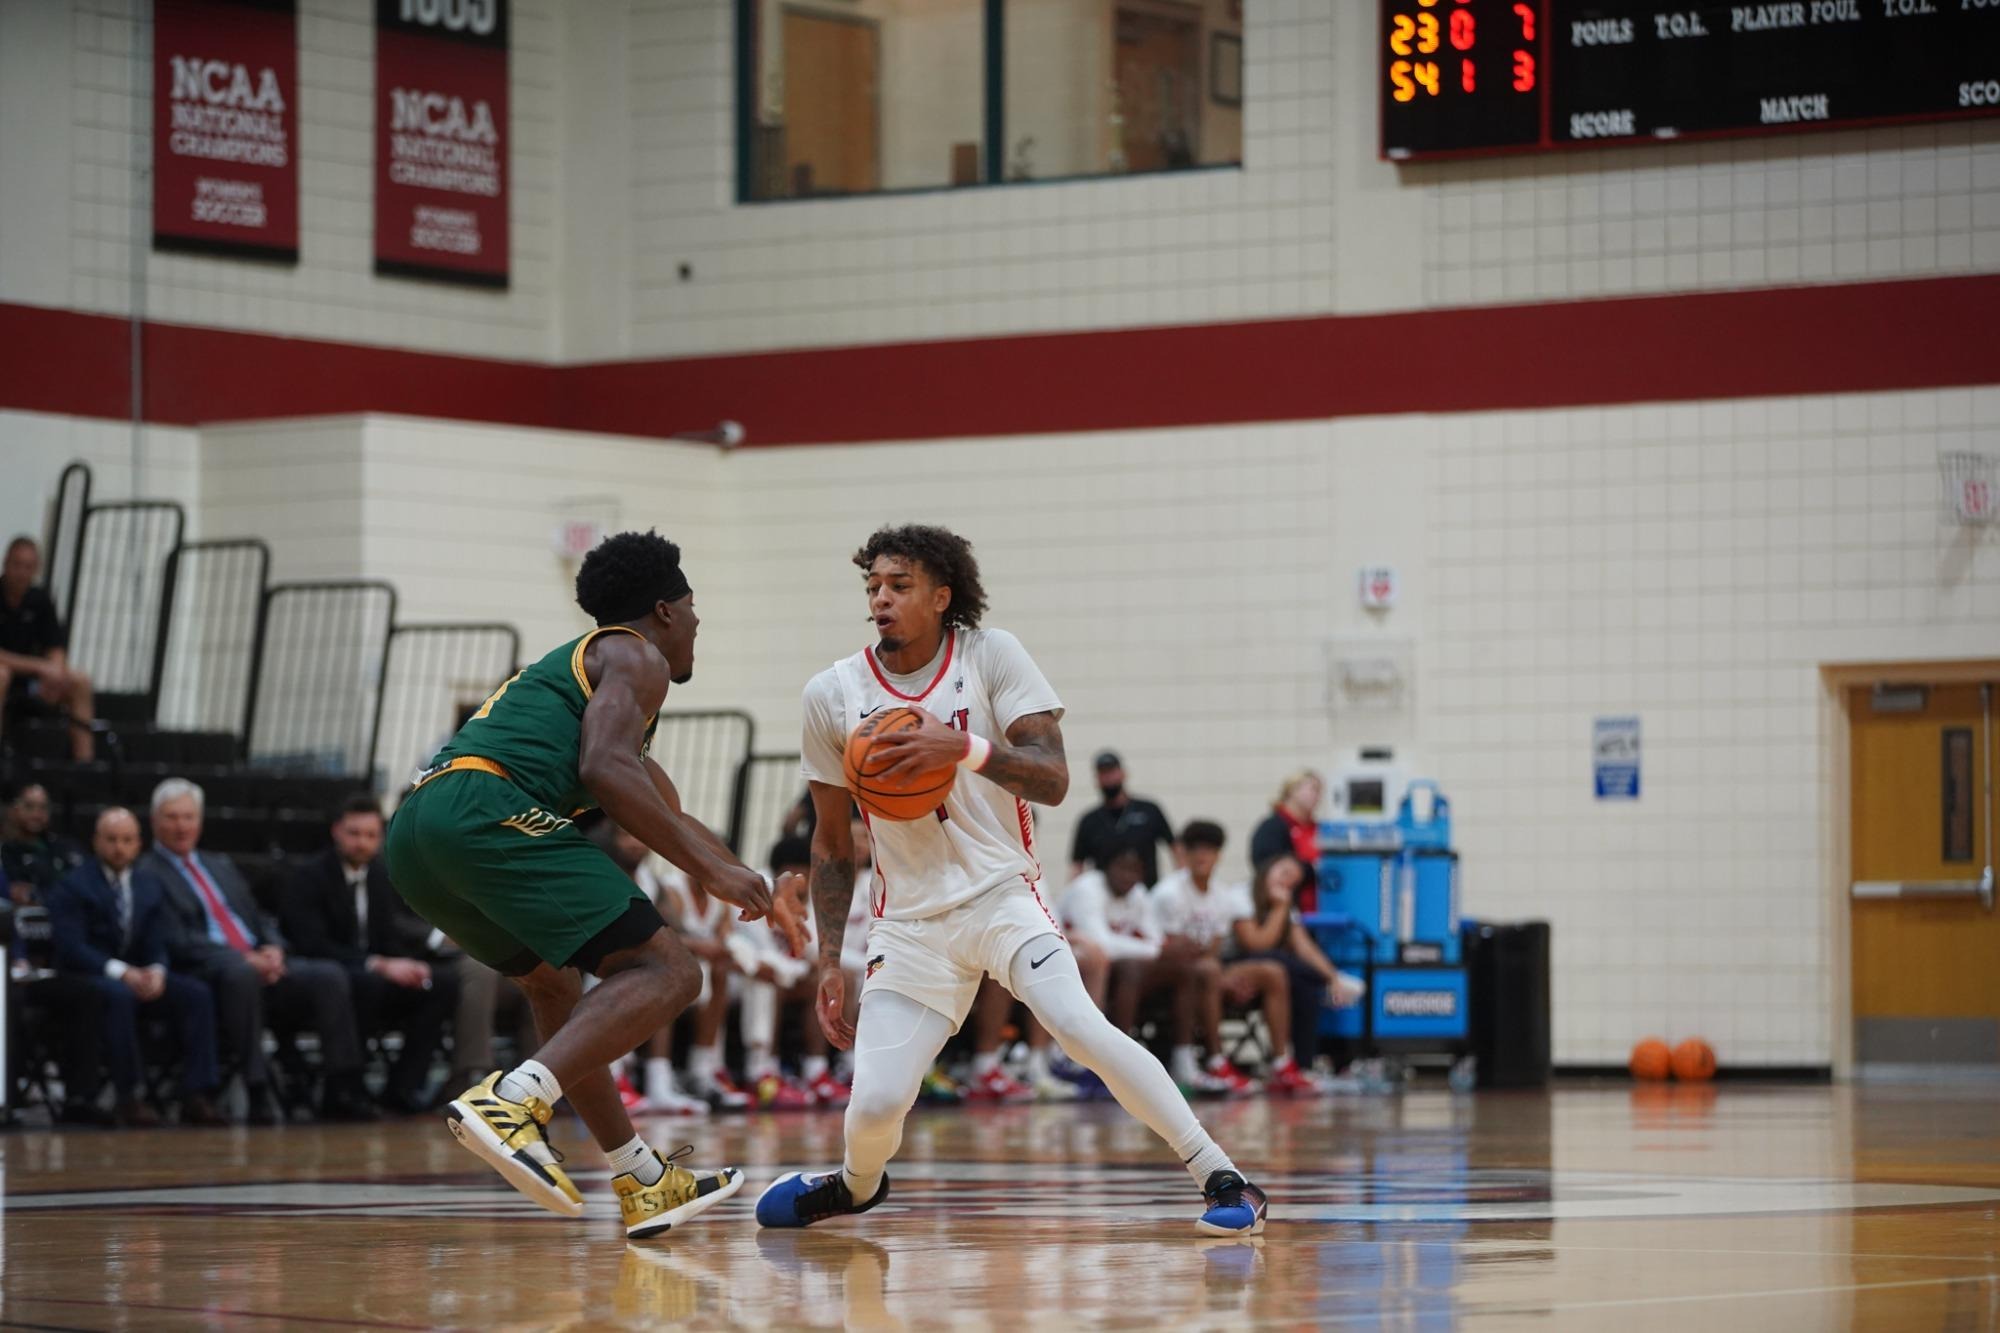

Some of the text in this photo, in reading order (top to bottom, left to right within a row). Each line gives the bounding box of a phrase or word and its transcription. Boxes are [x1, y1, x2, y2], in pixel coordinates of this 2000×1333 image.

[1390, 3, 1535, 55] 23 0 7
[1571, 18, 1635, 47] FOULS
[1654, 11, 1709, 39] T.O.L.
[1731, 0, 1860, 32] PLAYER FOUL
[170, 55, 285, 112] NCAA
[1390, 50, 1535, 102] 54 1 3
[171, 102, 287, 144] NATIONAL
[390, 86, 499, 145] NCAA
[1570, 109, 1635, 138] SCORE
[1760, 93, 1829, 124] MATCH
[170, 130, 288, 167] CHAMPIONS
